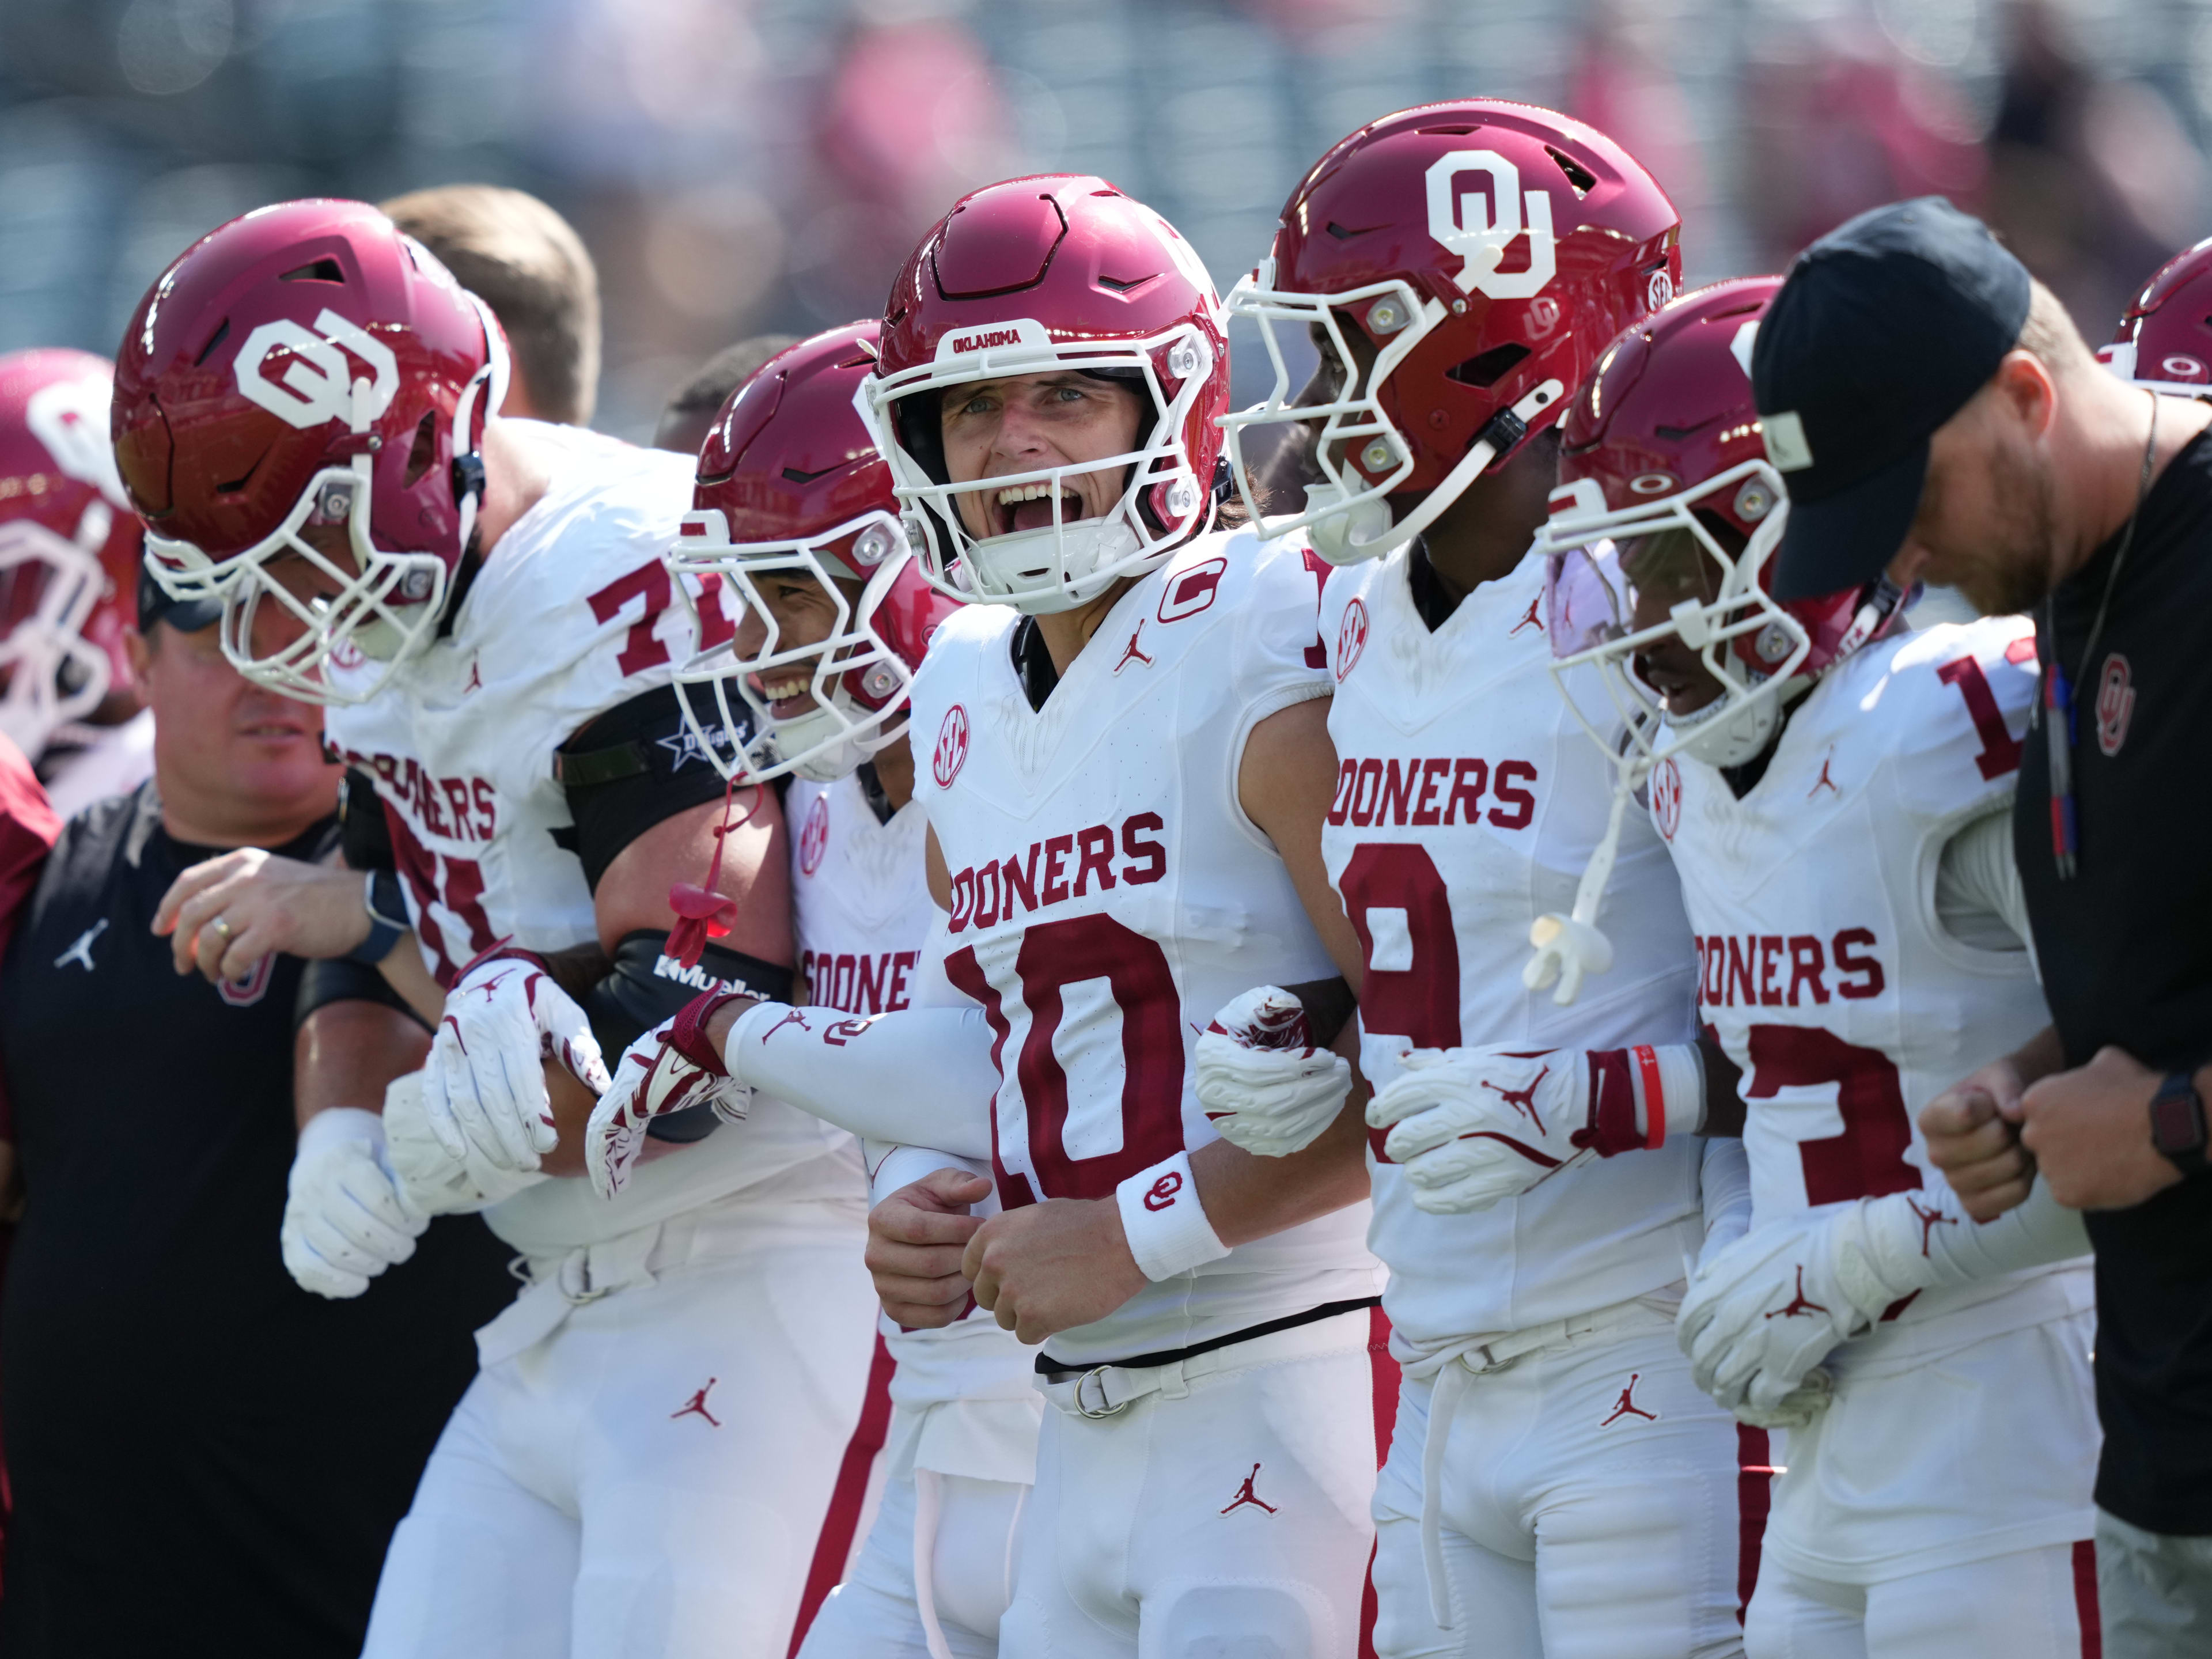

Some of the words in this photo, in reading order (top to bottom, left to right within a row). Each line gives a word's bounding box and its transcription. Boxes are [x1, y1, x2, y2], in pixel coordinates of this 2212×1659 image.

[1425, 150, 1556, 299] OU
[233, 307, 400, 430] OU
[953, 329, 1021, 354] OKLAHOMA
[586, 556, 737, 679] 71
[1157, 557, 1228, 624] C
[934, 706, 968, 786] SEC
[1936, 636, 2036, 782] 1
[1327, 757, 1537, 831] OONERS
[948, 811, 1166, 934] OONERS
[802, 949, 921, 1015] SOONE
[944, 912, 1185, 1212] 10
[1143, 1171, 1183, 1212] OU
